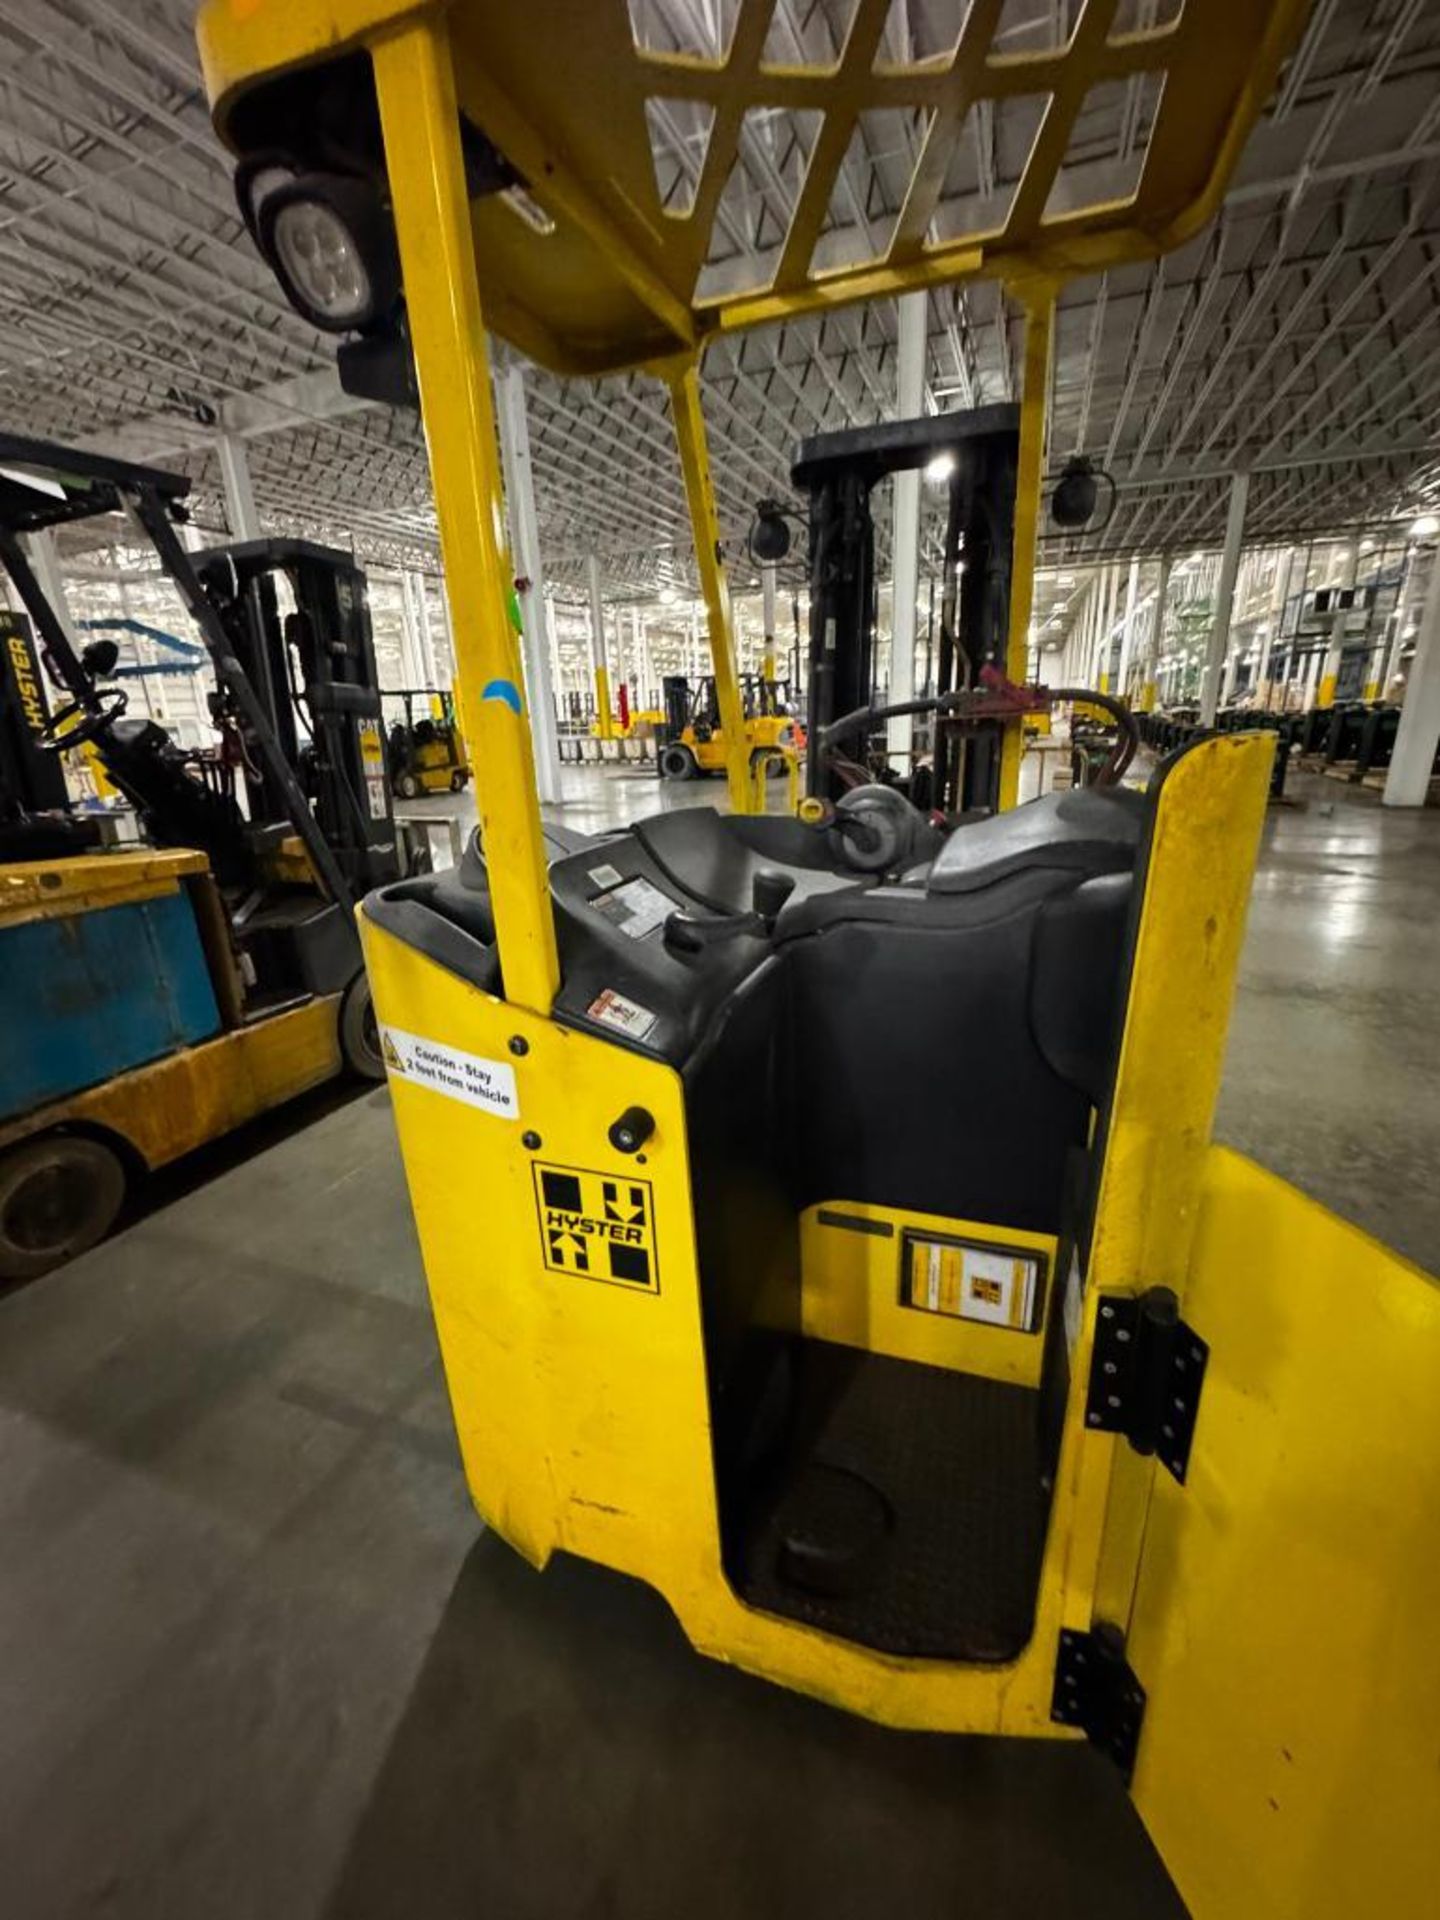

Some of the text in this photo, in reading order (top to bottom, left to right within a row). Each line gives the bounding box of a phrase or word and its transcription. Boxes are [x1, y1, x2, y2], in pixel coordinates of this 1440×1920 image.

[7, 637, 45, 729] HYSTER
[406, 1058, 510, 1105] 2 feet from vehicle
[415, 1046, 456, 1070] Caution
[464, 1064, 491, 1085] Stay
[547, 1211, 643, 1244] HYSTER
